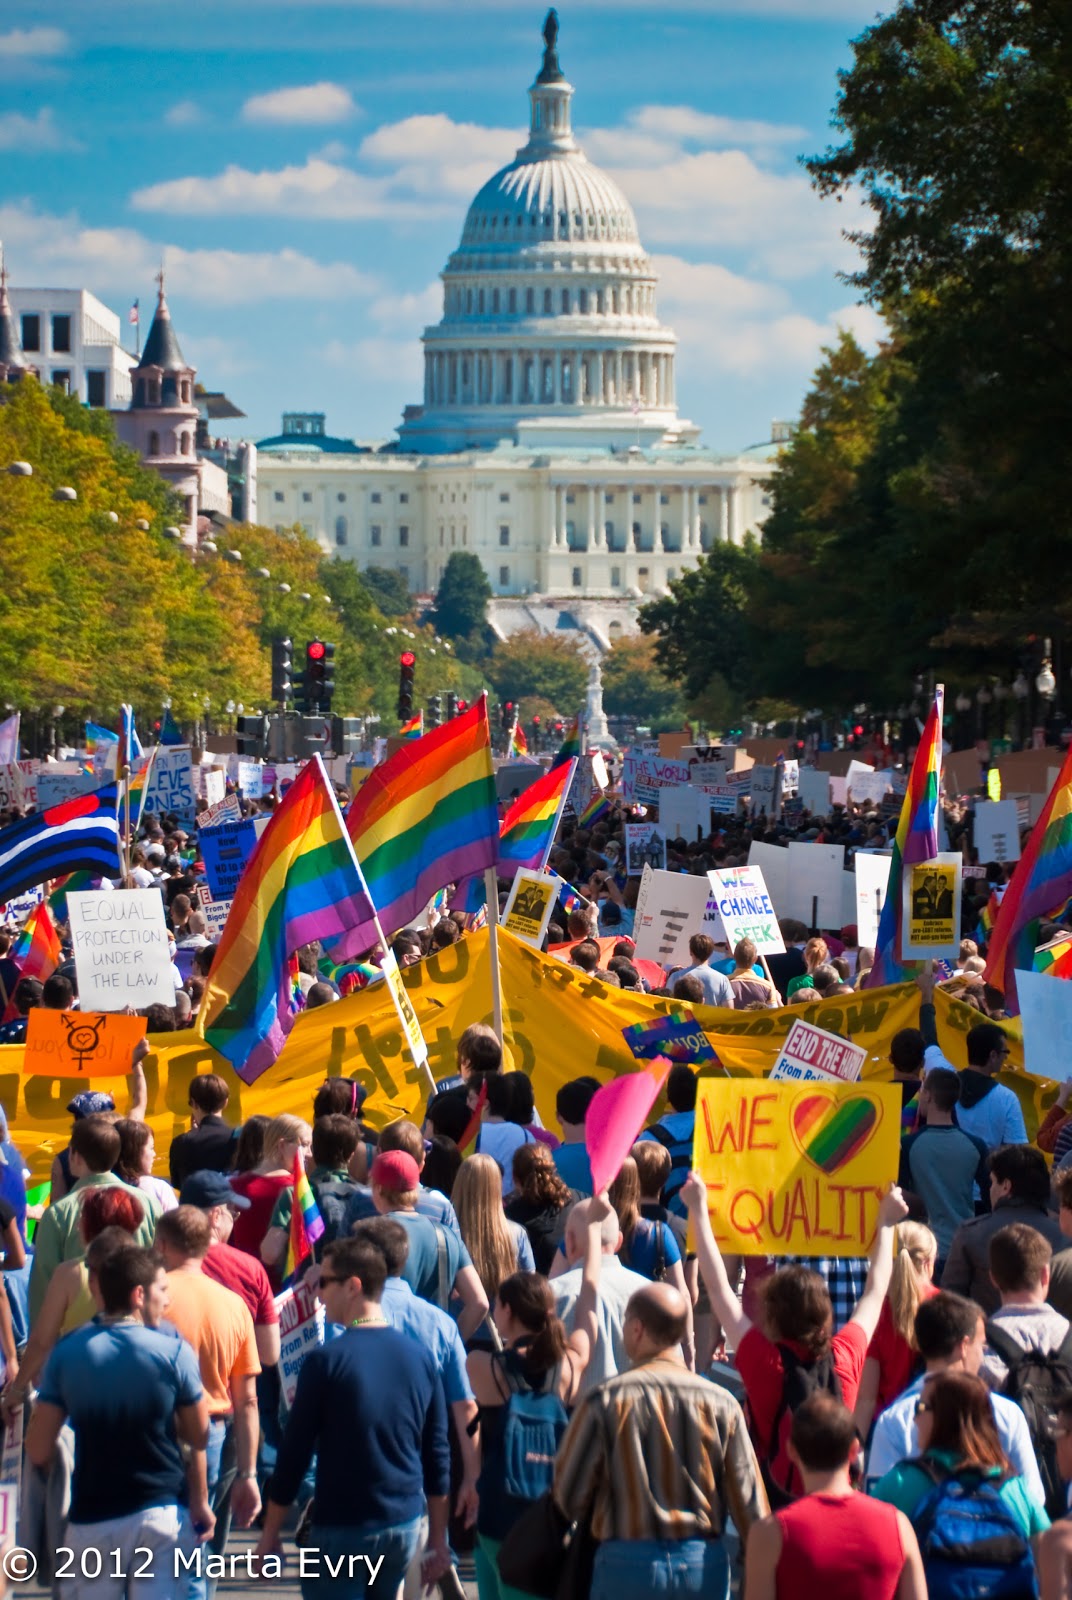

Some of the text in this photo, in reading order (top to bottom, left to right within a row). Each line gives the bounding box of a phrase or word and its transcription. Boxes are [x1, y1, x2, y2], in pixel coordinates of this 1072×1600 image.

[172, 753, 188, 764] TO
[696, 746, 722, 758] WE
[7, 761, 32, 776] LVE
[624, 757, 651, 776] THE
[653, 762, 691, 782] WORLD
[9, 786, 37, 803] LVE
[200, 819, 253, 837] Equal Rights
[218, 835, 239, 847] Now!
[716, 867, 754, 888] WE
[724, 889, 739, 899] ARE
[742, 886, 761, 896] THE
[80, 900, 156, 921] EQUAL
[205, 905, 224, 914] From
[720, 895, 773, 917] CHANGE
[207, 912, 228, 922] Bigotr
[75, 929, 161, 947] PROTECTION
[92, 950, 144, 966] UNDER
[91, 973, 159, 988] THE LAW
[786, 1026, 819, 1061] END
[817, 1038, 843, 1073] THE
[778, 1058, 802, 1079] From
[701, 1093, 778, 1154] WE
[281, 1336, 302, 1359] From
